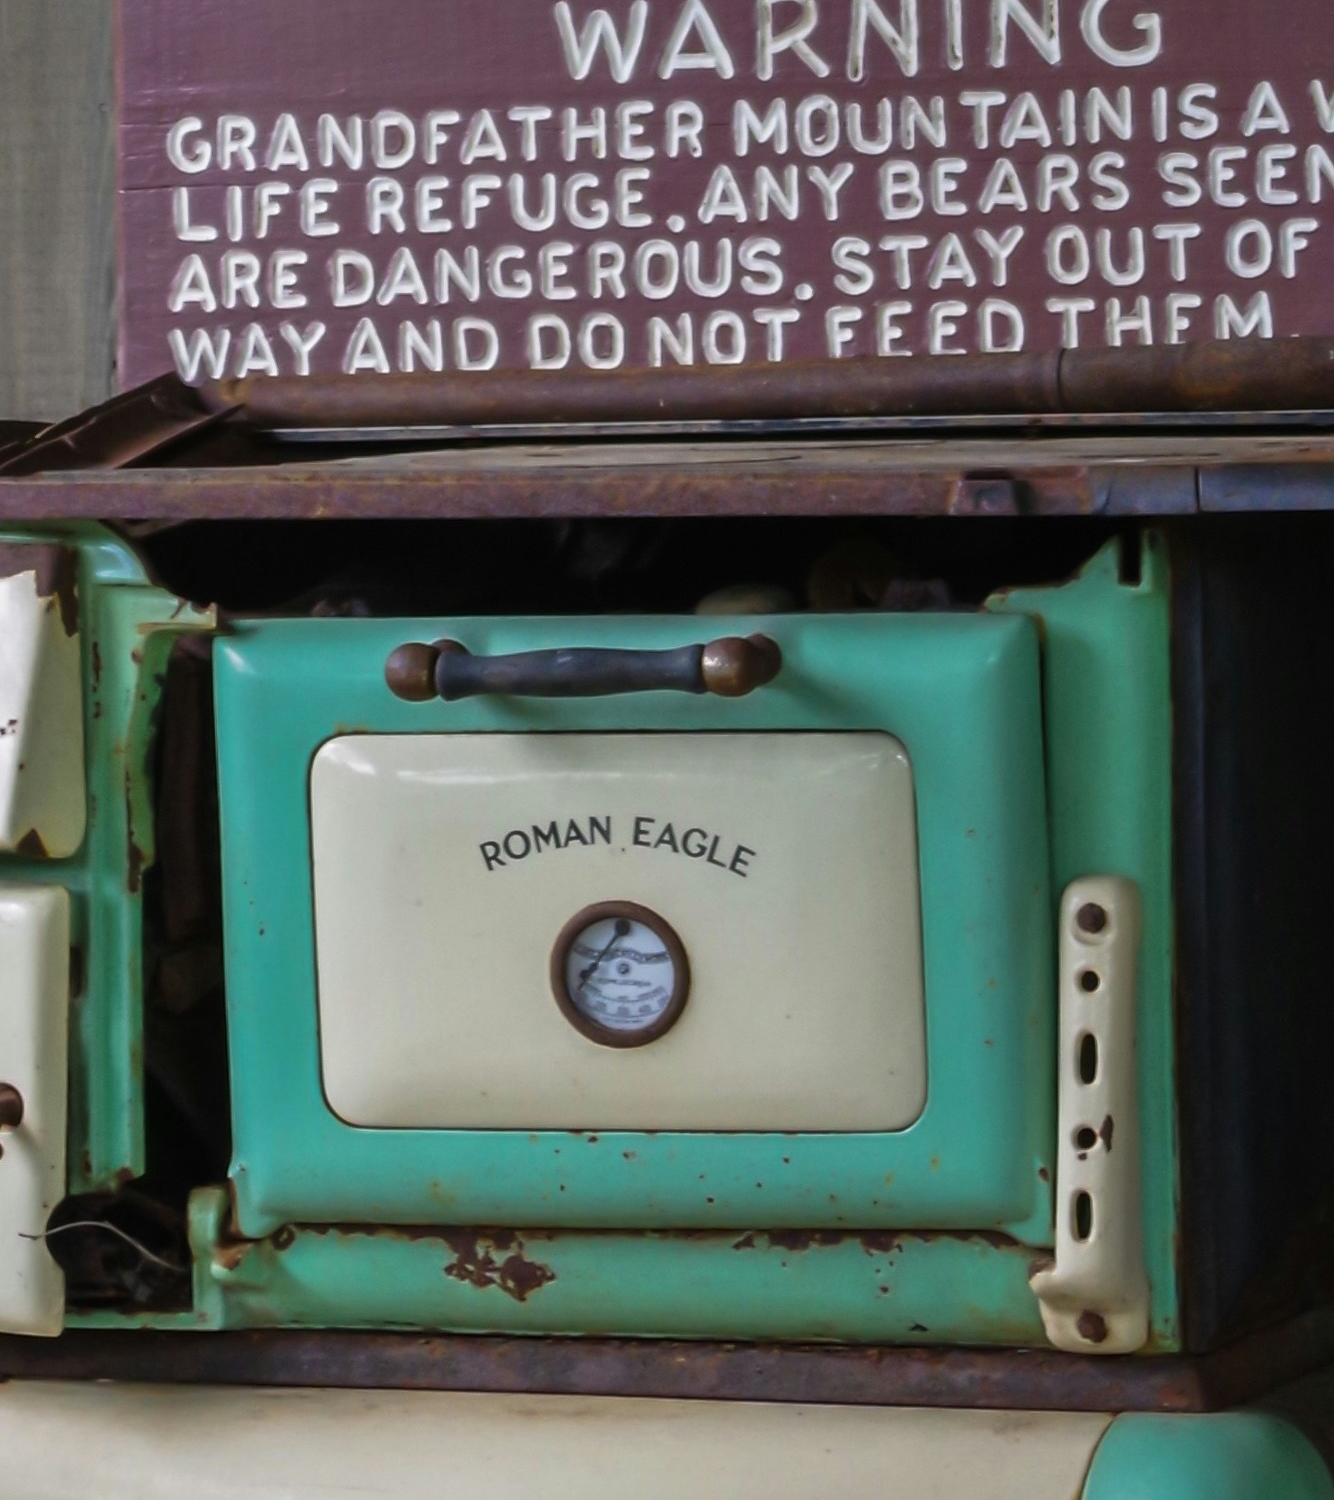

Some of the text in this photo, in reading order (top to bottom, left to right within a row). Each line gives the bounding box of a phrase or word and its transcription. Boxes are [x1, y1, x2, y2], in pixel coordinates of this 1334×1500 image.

[167, 100, 704, 173] GRANDFATHER
[734, 86, 1132, 158] MOUNTAIN
[1152, 83, 1219, 142] IS
[1243, 81, 1290, 136] A
[172, 178, 340, 242] LIFE
[698, 162, 854, 223] ANY
[879, 152, 1129, 221] BEARS
[169, 250, 309, 313] ARE
[330, 238, 814, 308] DANGEROUS.
[832, 226, 1024, 295] STAY
[1045, 223, 1202, 287] OUT
[1225, 217, 1319, 278] OF
[167, 290, 1300, 382] WAY AND DO NOT FEED THEM
[479, 816, 756, 878] ROMAN EAGLE
